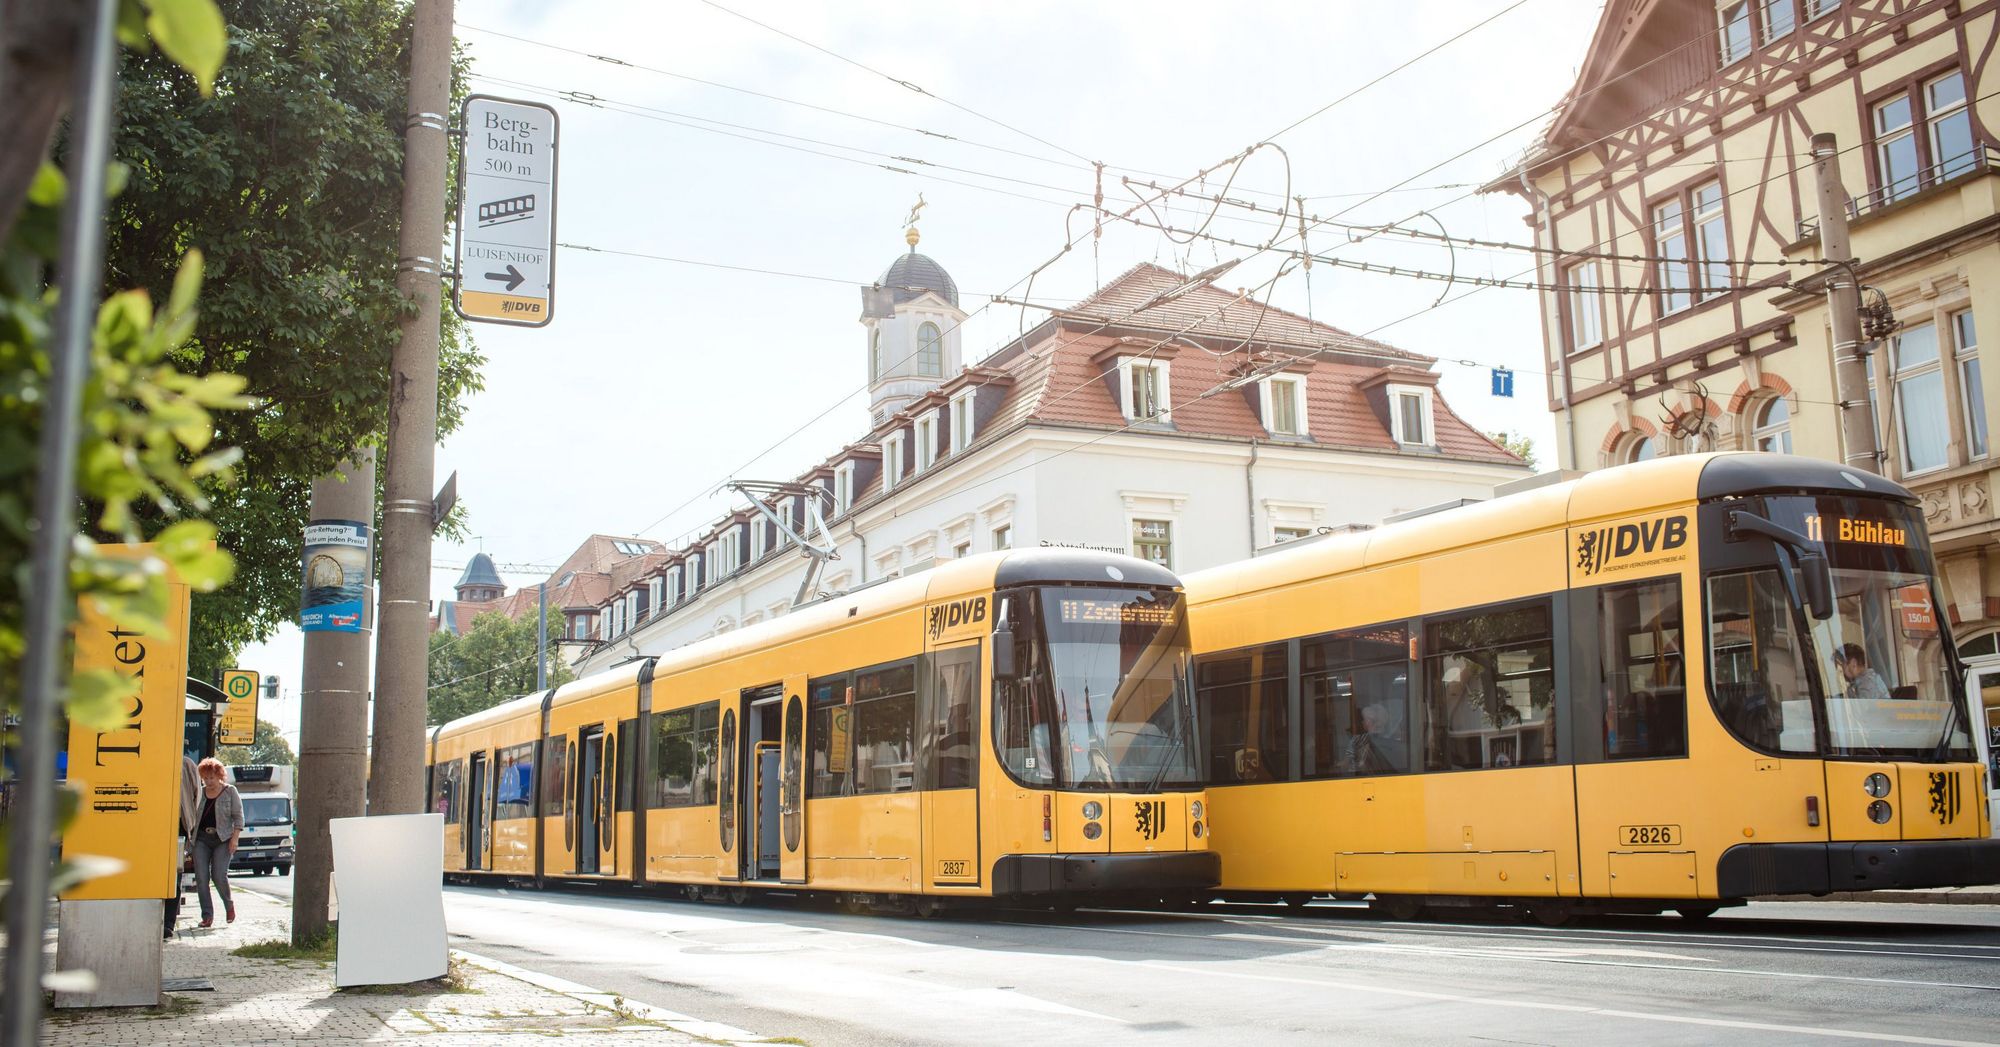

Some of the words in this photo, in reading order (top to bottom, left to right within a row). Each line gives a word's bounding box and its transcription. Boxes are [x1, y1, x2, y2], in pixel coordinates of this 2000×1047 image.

[485, 111, 539, 138] Berg-
[487, 132, 534, 155] bahn
[484, 158, 512, 173] 500
[518, 165, 531, 176] m
[468, 247, 544, 264] LUISENHOF
[515, 301, 541, 313] DVB
[1614, 515, 1688, 558] DVB
[1804, 515, 1822, 541] 11
[1839, 518, 1905, 546] Bühlau
[947, 596, 987, 628] DVB
[1063, 601, 1077, 619] 11
[95, 625, 146, 767] Ticet
[235, 680, 246, 694] H
[1629, 826, 1671, 845] 2826
[943, 861, 965, 875] 2837
